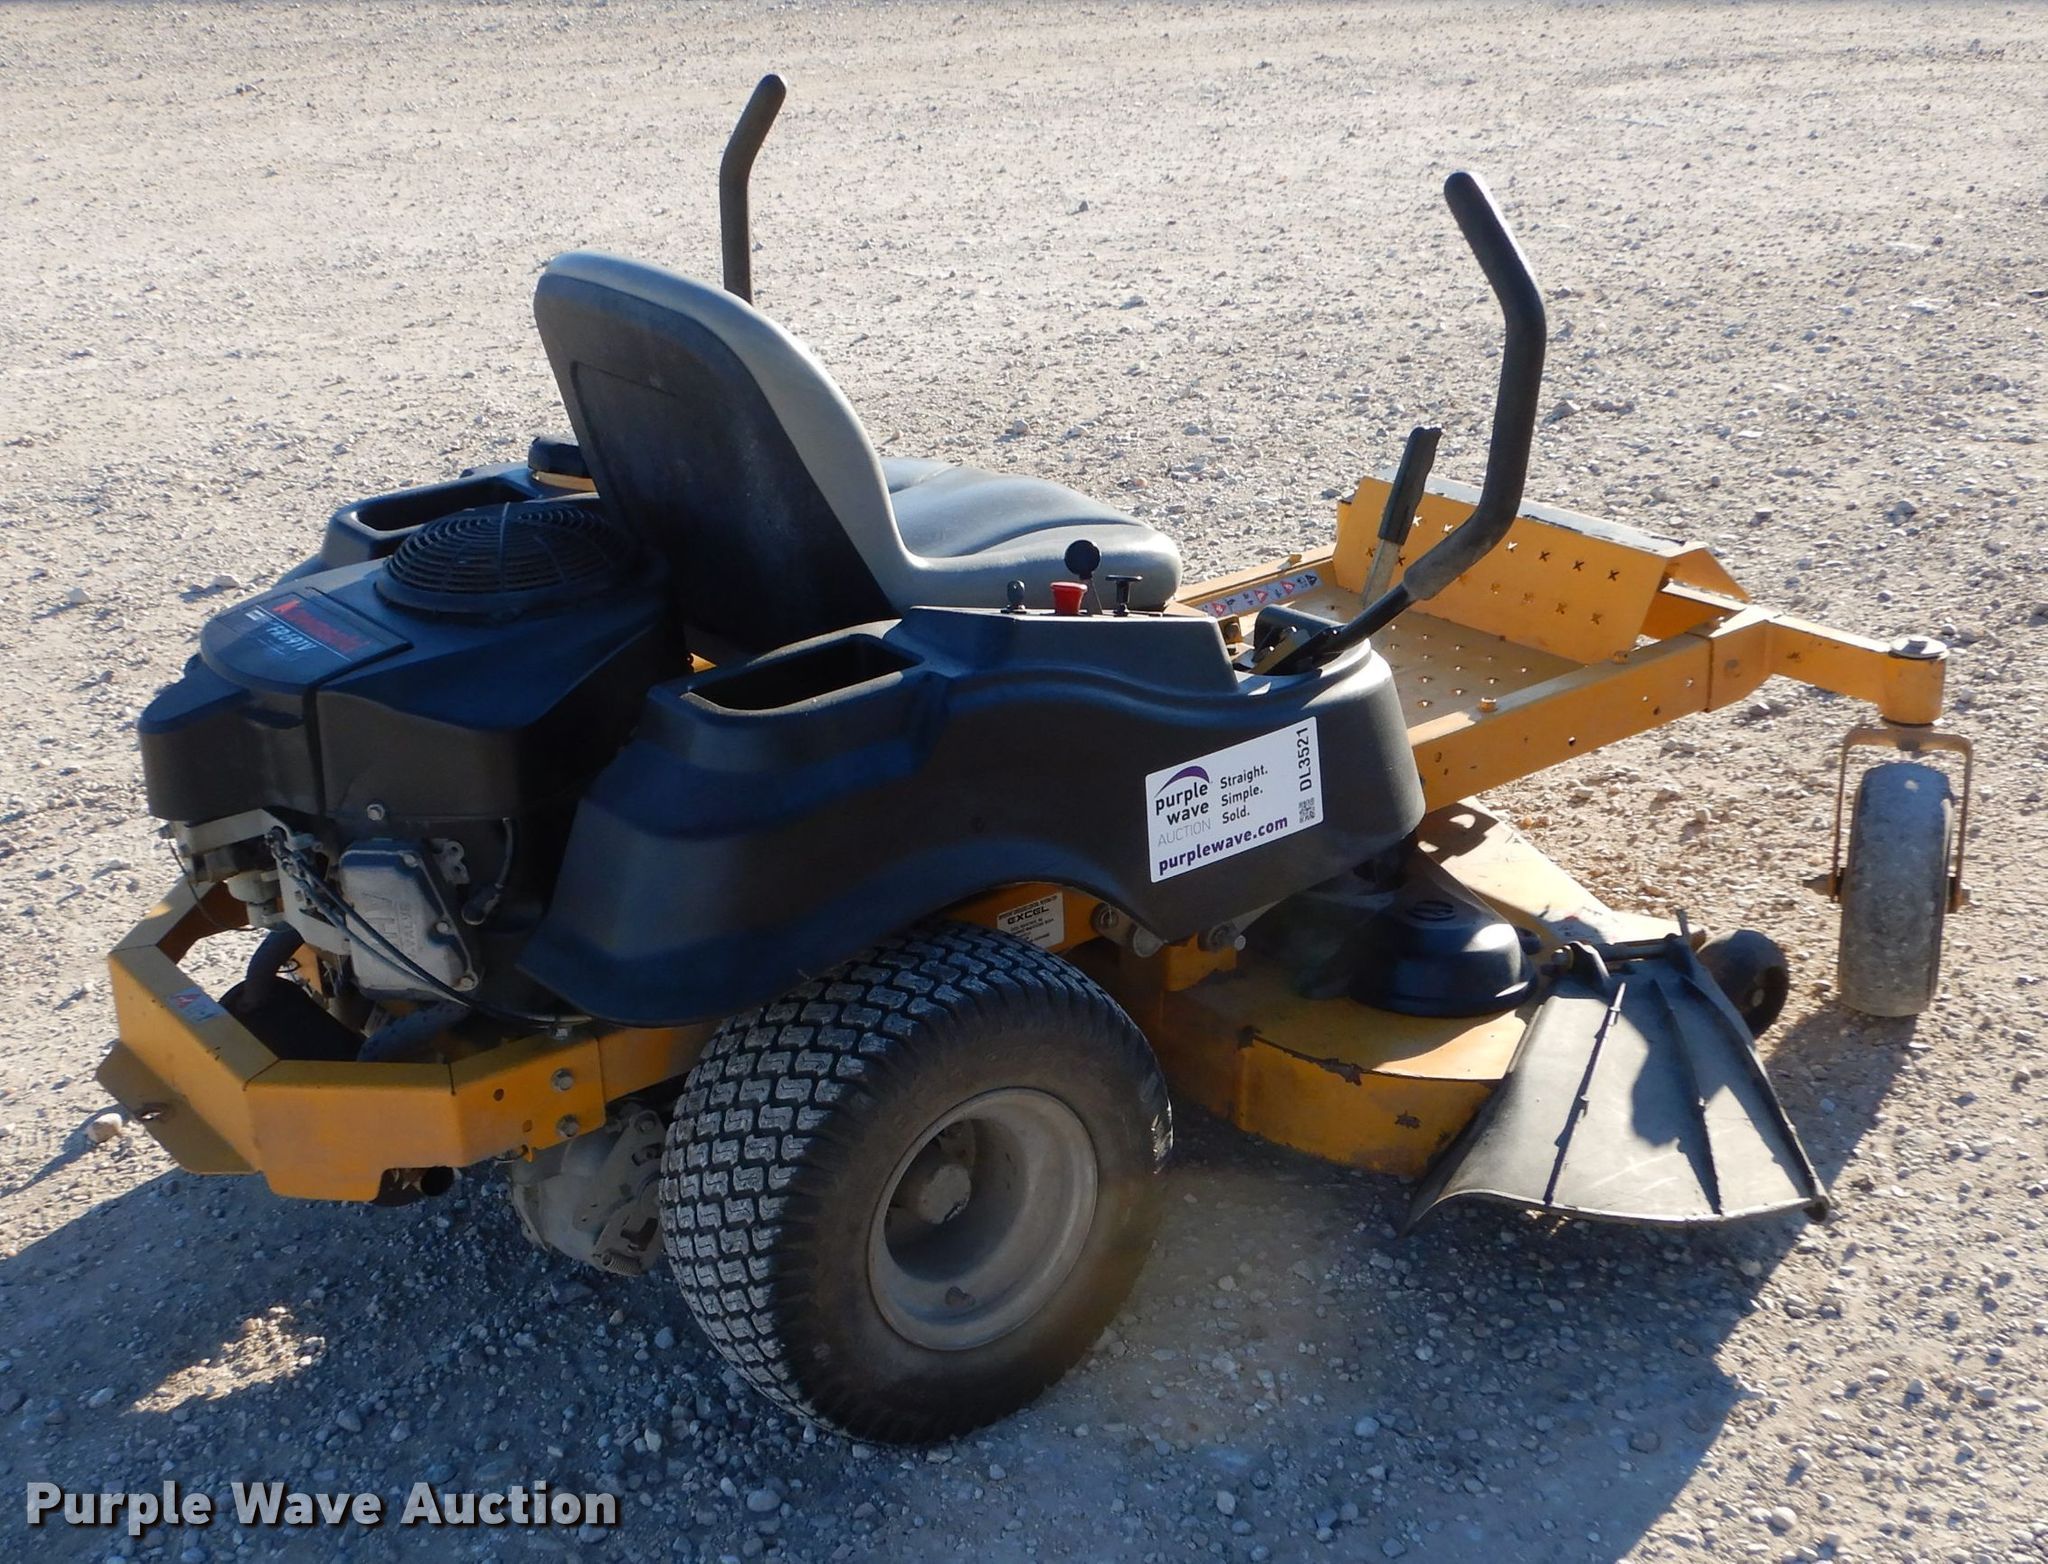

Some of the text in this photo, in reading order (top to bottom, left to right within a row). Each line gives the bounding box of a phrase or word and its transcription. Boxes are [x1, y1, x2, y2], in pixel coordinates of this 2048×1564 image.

[1296, 727, 1312, 792] DL3521
[1220, 764, 1268, 790] Straight.
[1155, 782, 1209, 815] purple
[1221, 785, 1263, 807] Simple.
[1167, 801, 1209, 825] wave
[1222, 805, 1250, 824] Sold.
[1158, 818, 1211, 847] AUCTION
[1159, 817, 1288, 876] purplewave.com
[1007, 905, 1050, 925] EXCEL
